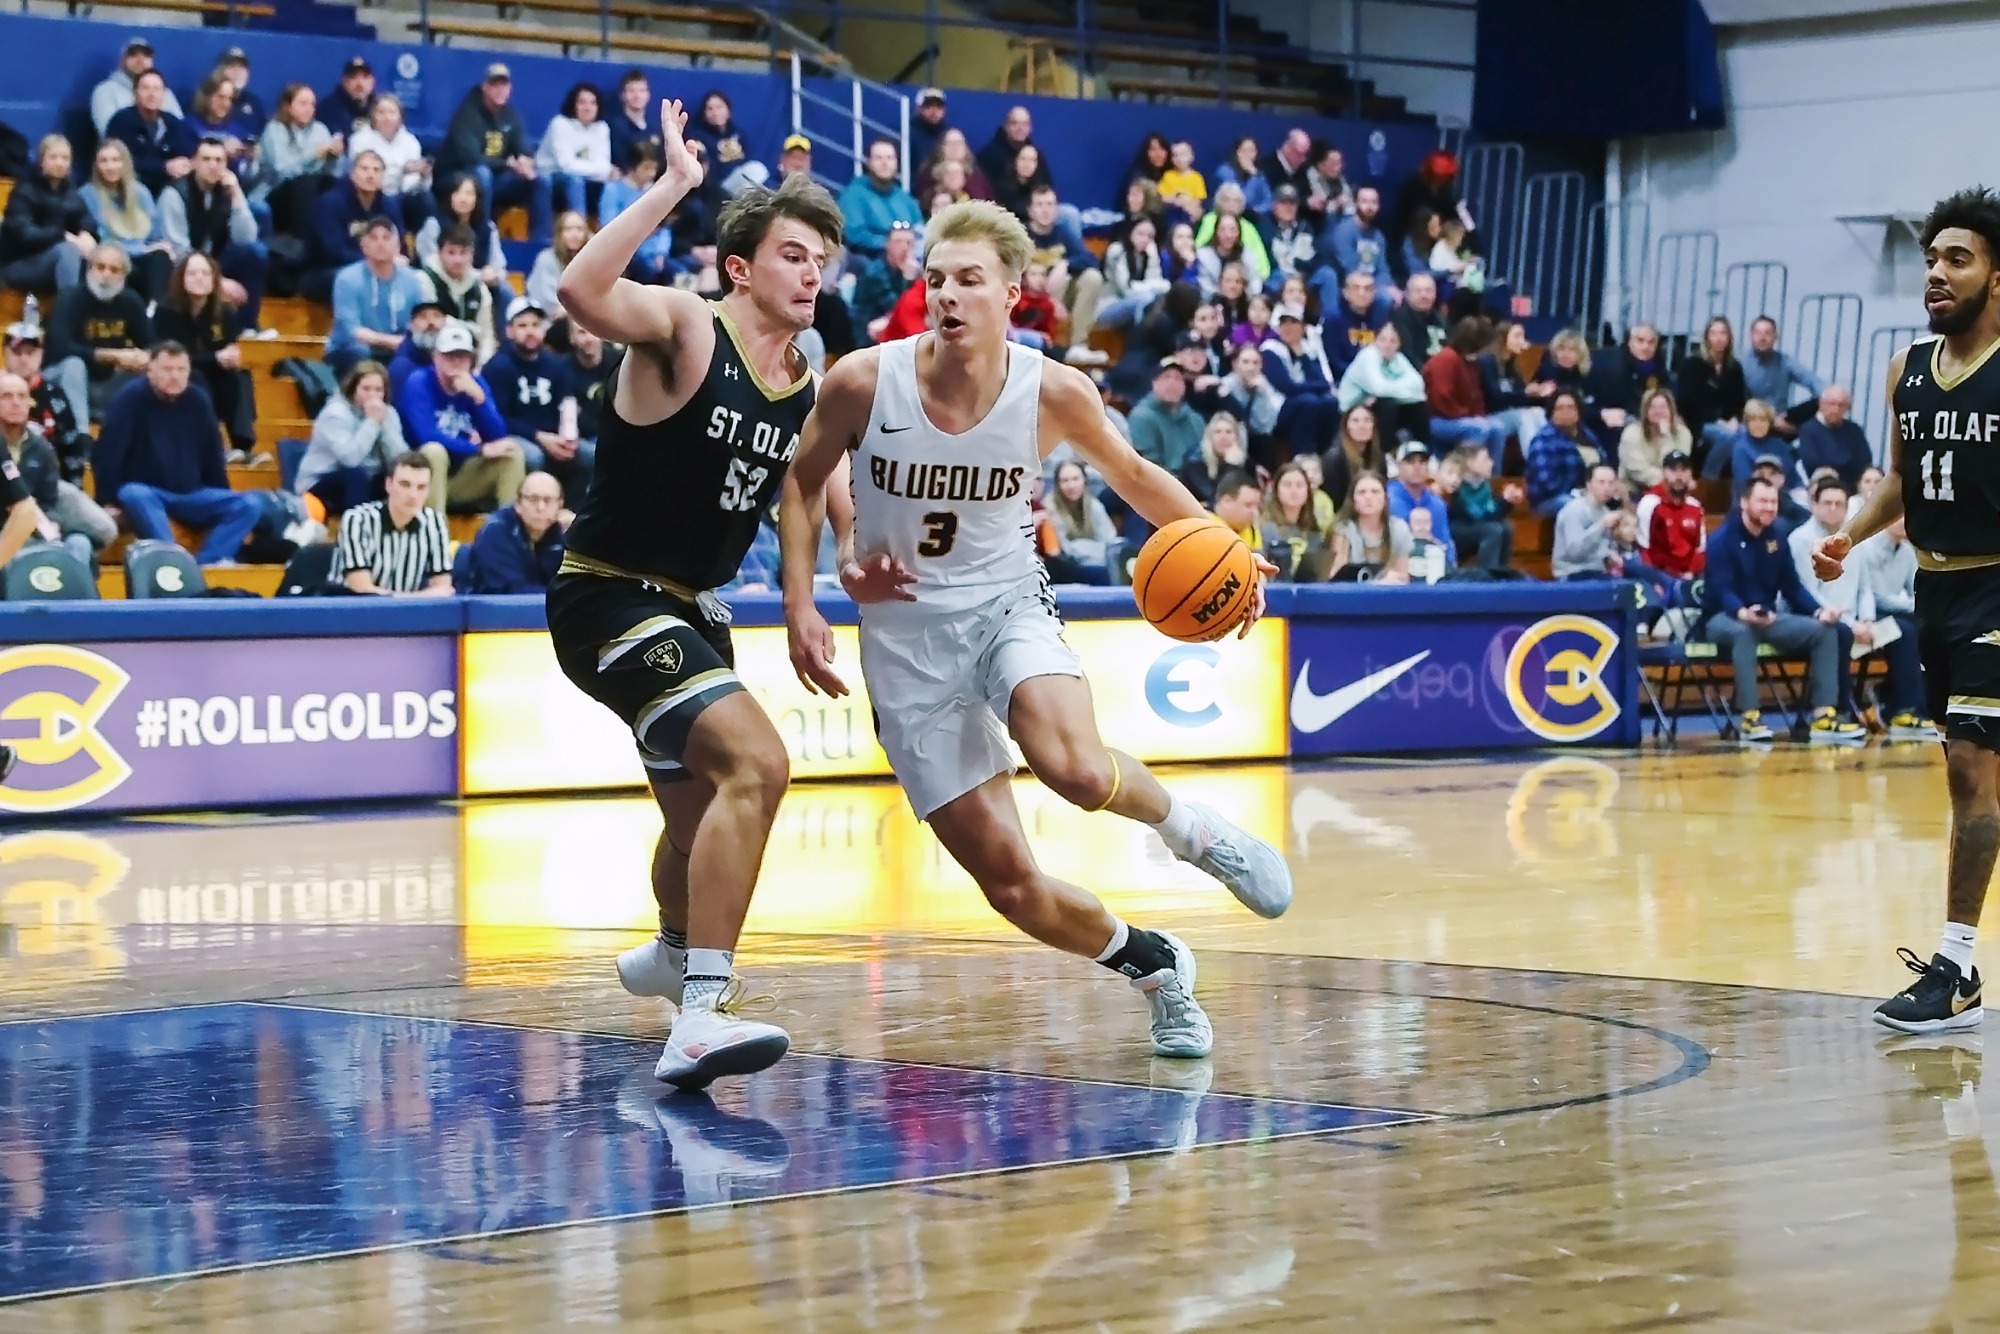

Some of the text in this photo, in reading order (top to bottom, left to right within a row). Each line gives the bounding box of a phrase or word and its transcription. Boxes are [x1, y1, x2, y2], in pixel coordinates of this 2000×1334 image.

[706, 405, 800, 462] ST. OLA
[1899, 410, 2000, 443] ST. OLAF
[719, 457, 769, 511] 52
[871, 455, 1025, 501] BLUGOLDS
[1920, 450, 1955, 502] 11
[917, 510, 960, 558] 3
[1191, 572, 1241, 624] NCAA
[136, 689, 458, 748] #ROLLGOLDS
[766, 695, 857, 762] au
